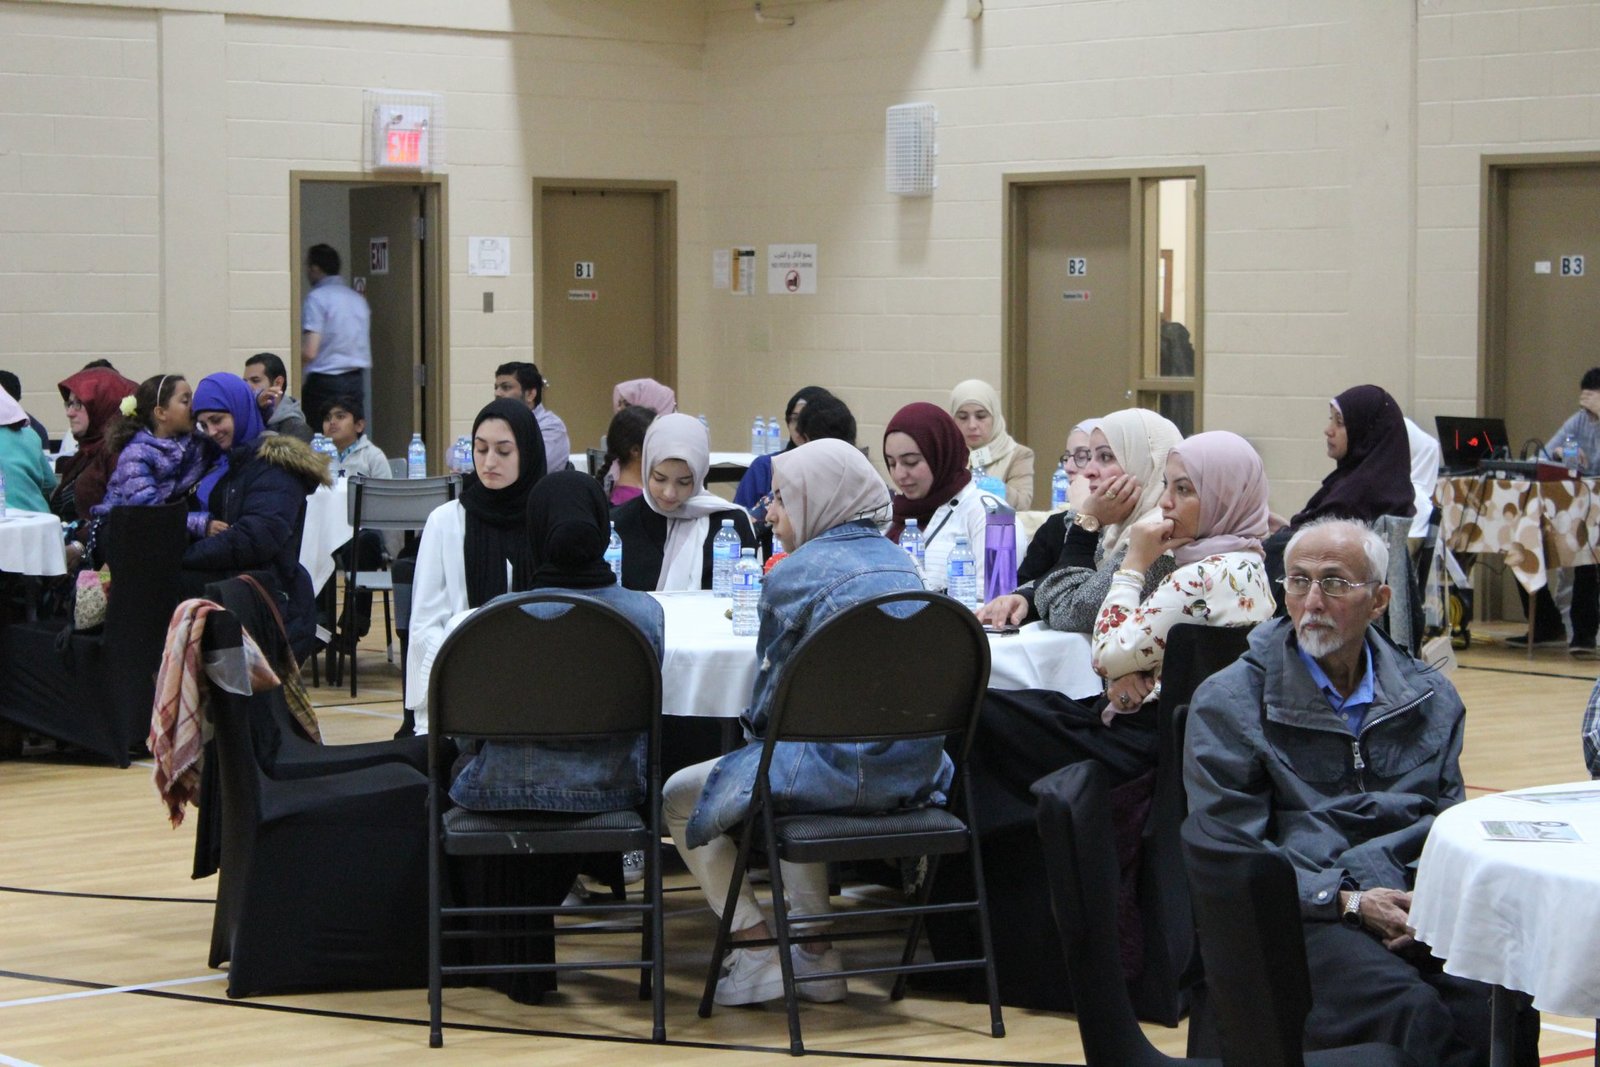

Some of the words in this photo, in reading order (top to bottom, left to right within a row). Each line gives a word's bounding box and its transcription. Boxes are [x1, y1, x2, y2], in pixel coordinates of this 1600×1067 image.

[387, 131, 420, 163] EXIT
[371, 242, 387, 270] EXIT
[576, 263, 591, 277] B1
[1069, 259, 1085, 274] B2
[1562, 257, 1582, 275] B3
